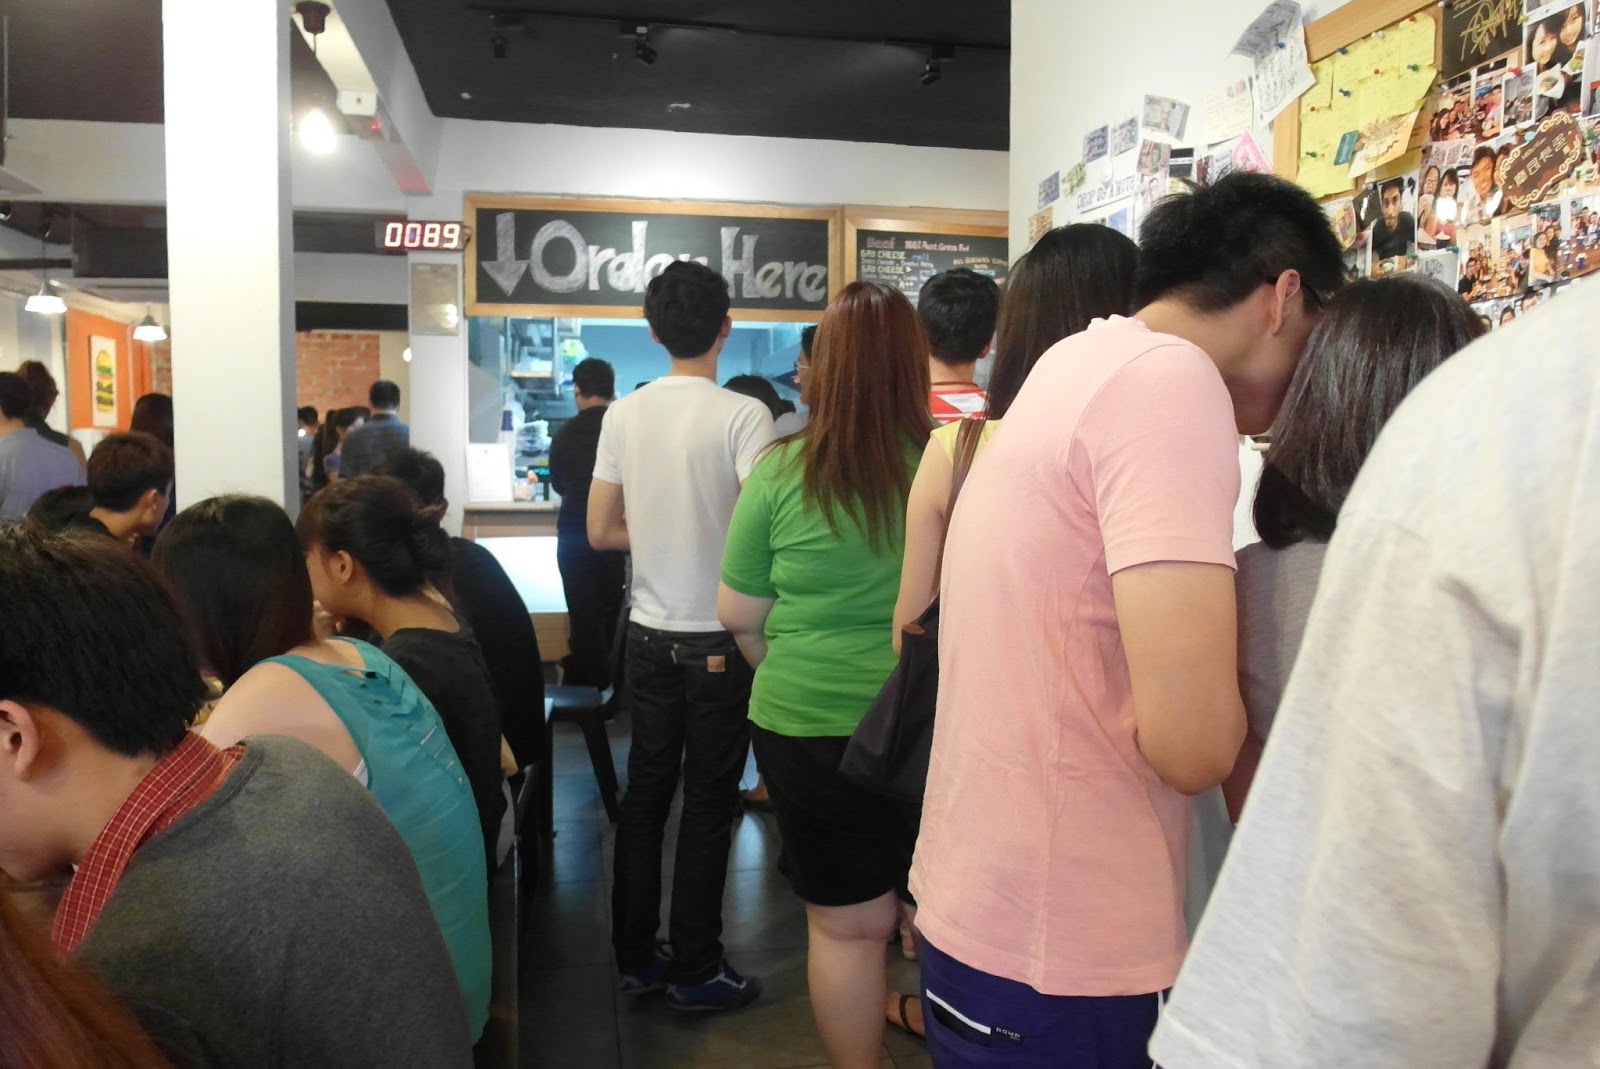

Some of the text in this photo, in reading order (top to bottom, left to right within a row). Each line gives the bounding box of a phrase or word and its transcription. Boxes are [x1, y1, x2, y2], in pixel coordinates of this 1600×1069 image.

[384, 222, 461, 249] 0089
[530, 220, 827, 302] Orde Here
[877, 250, 906, 259] CHEESE
[877, 266, 905, 274] CHEESE
